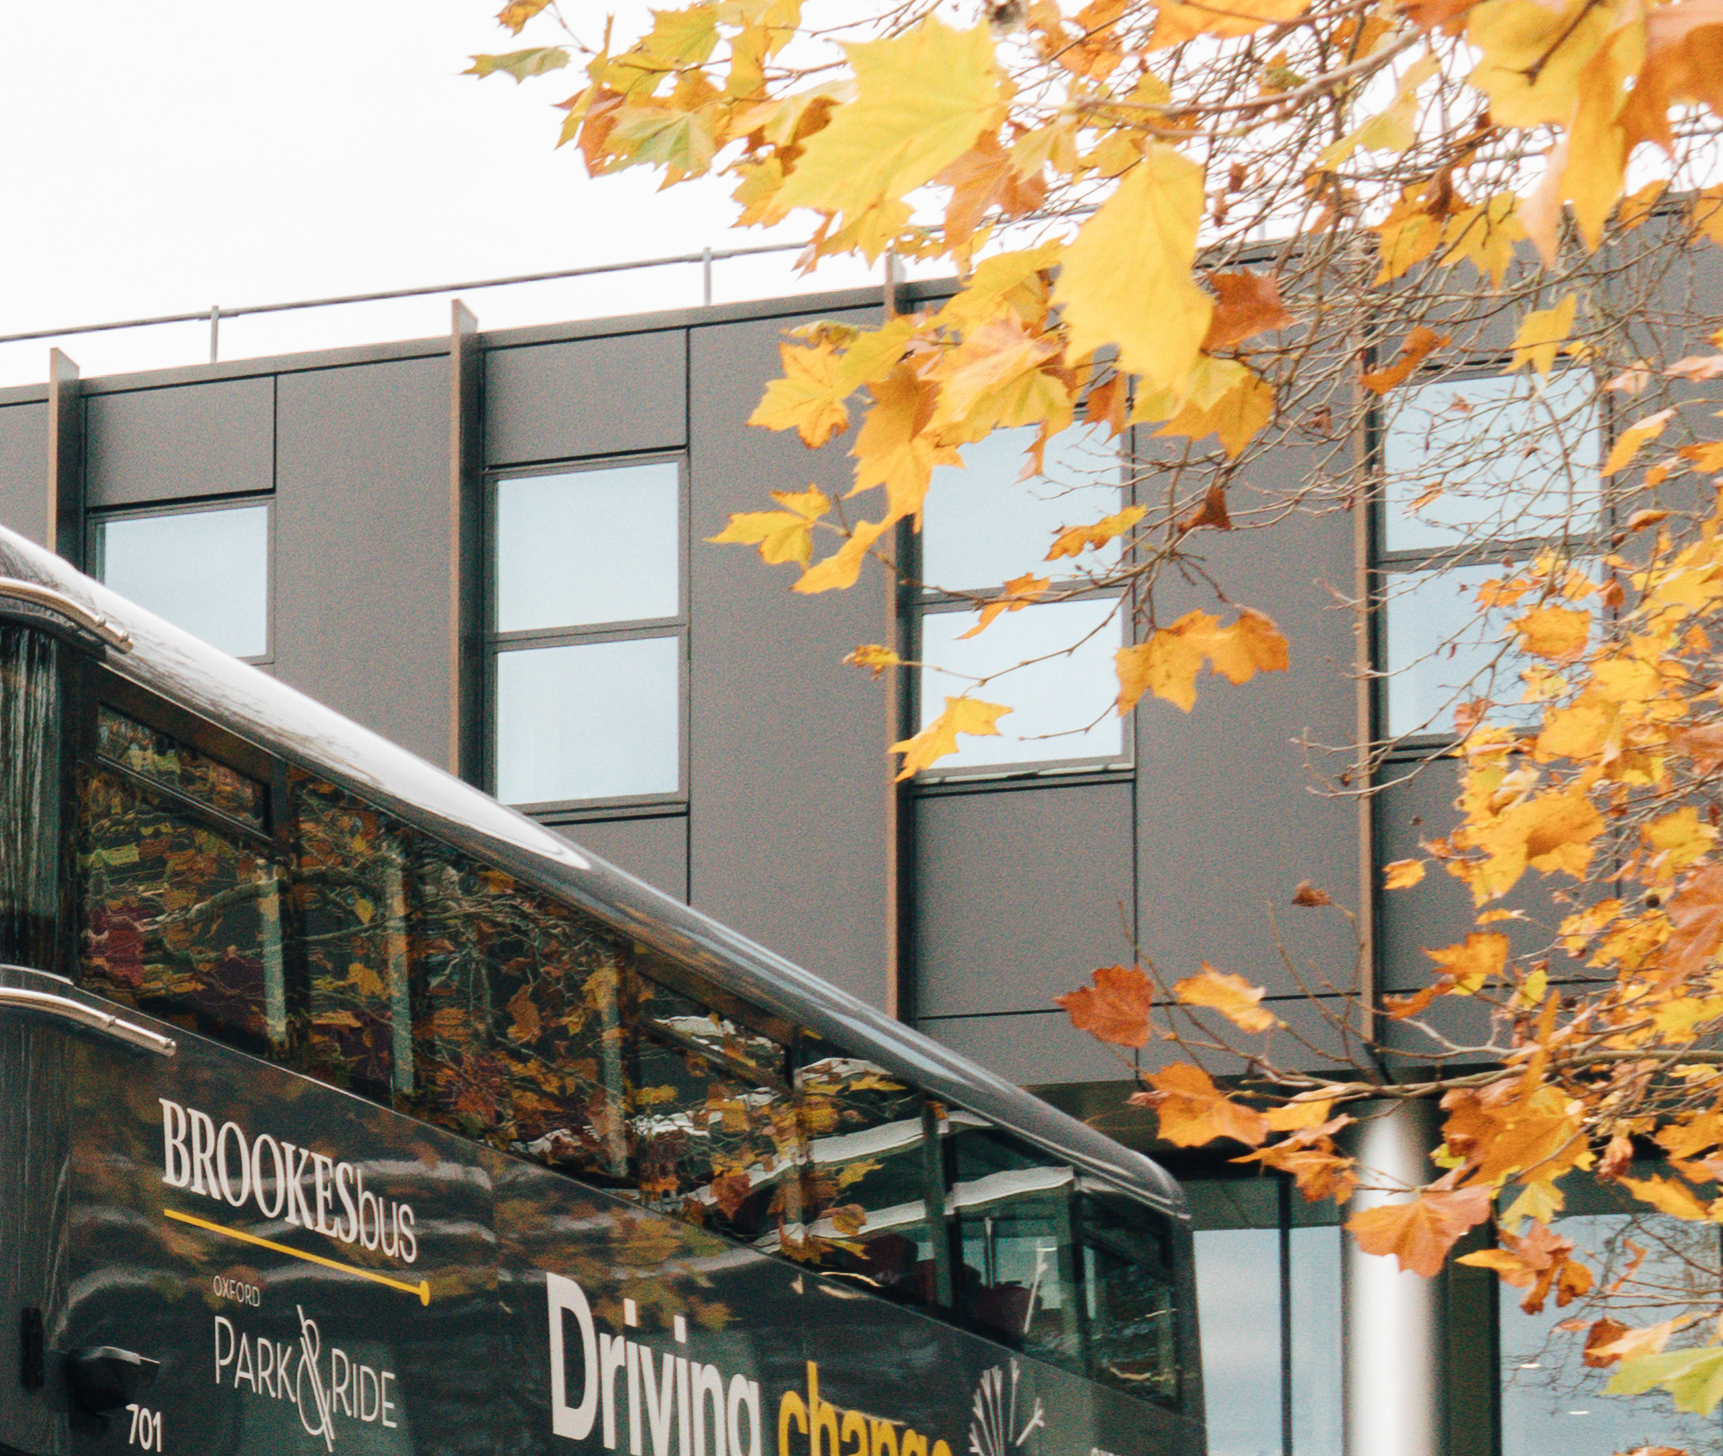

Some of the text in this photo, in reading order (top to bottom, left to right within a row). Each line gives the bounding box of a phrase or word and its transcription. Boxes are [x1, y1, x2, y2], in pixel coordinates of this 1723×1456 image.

[159, 1098, 417, 1263] BROOKESbus
[213, 1275, 260, 1307] OXFORD
[126, 1404, 162, 1452] 701
